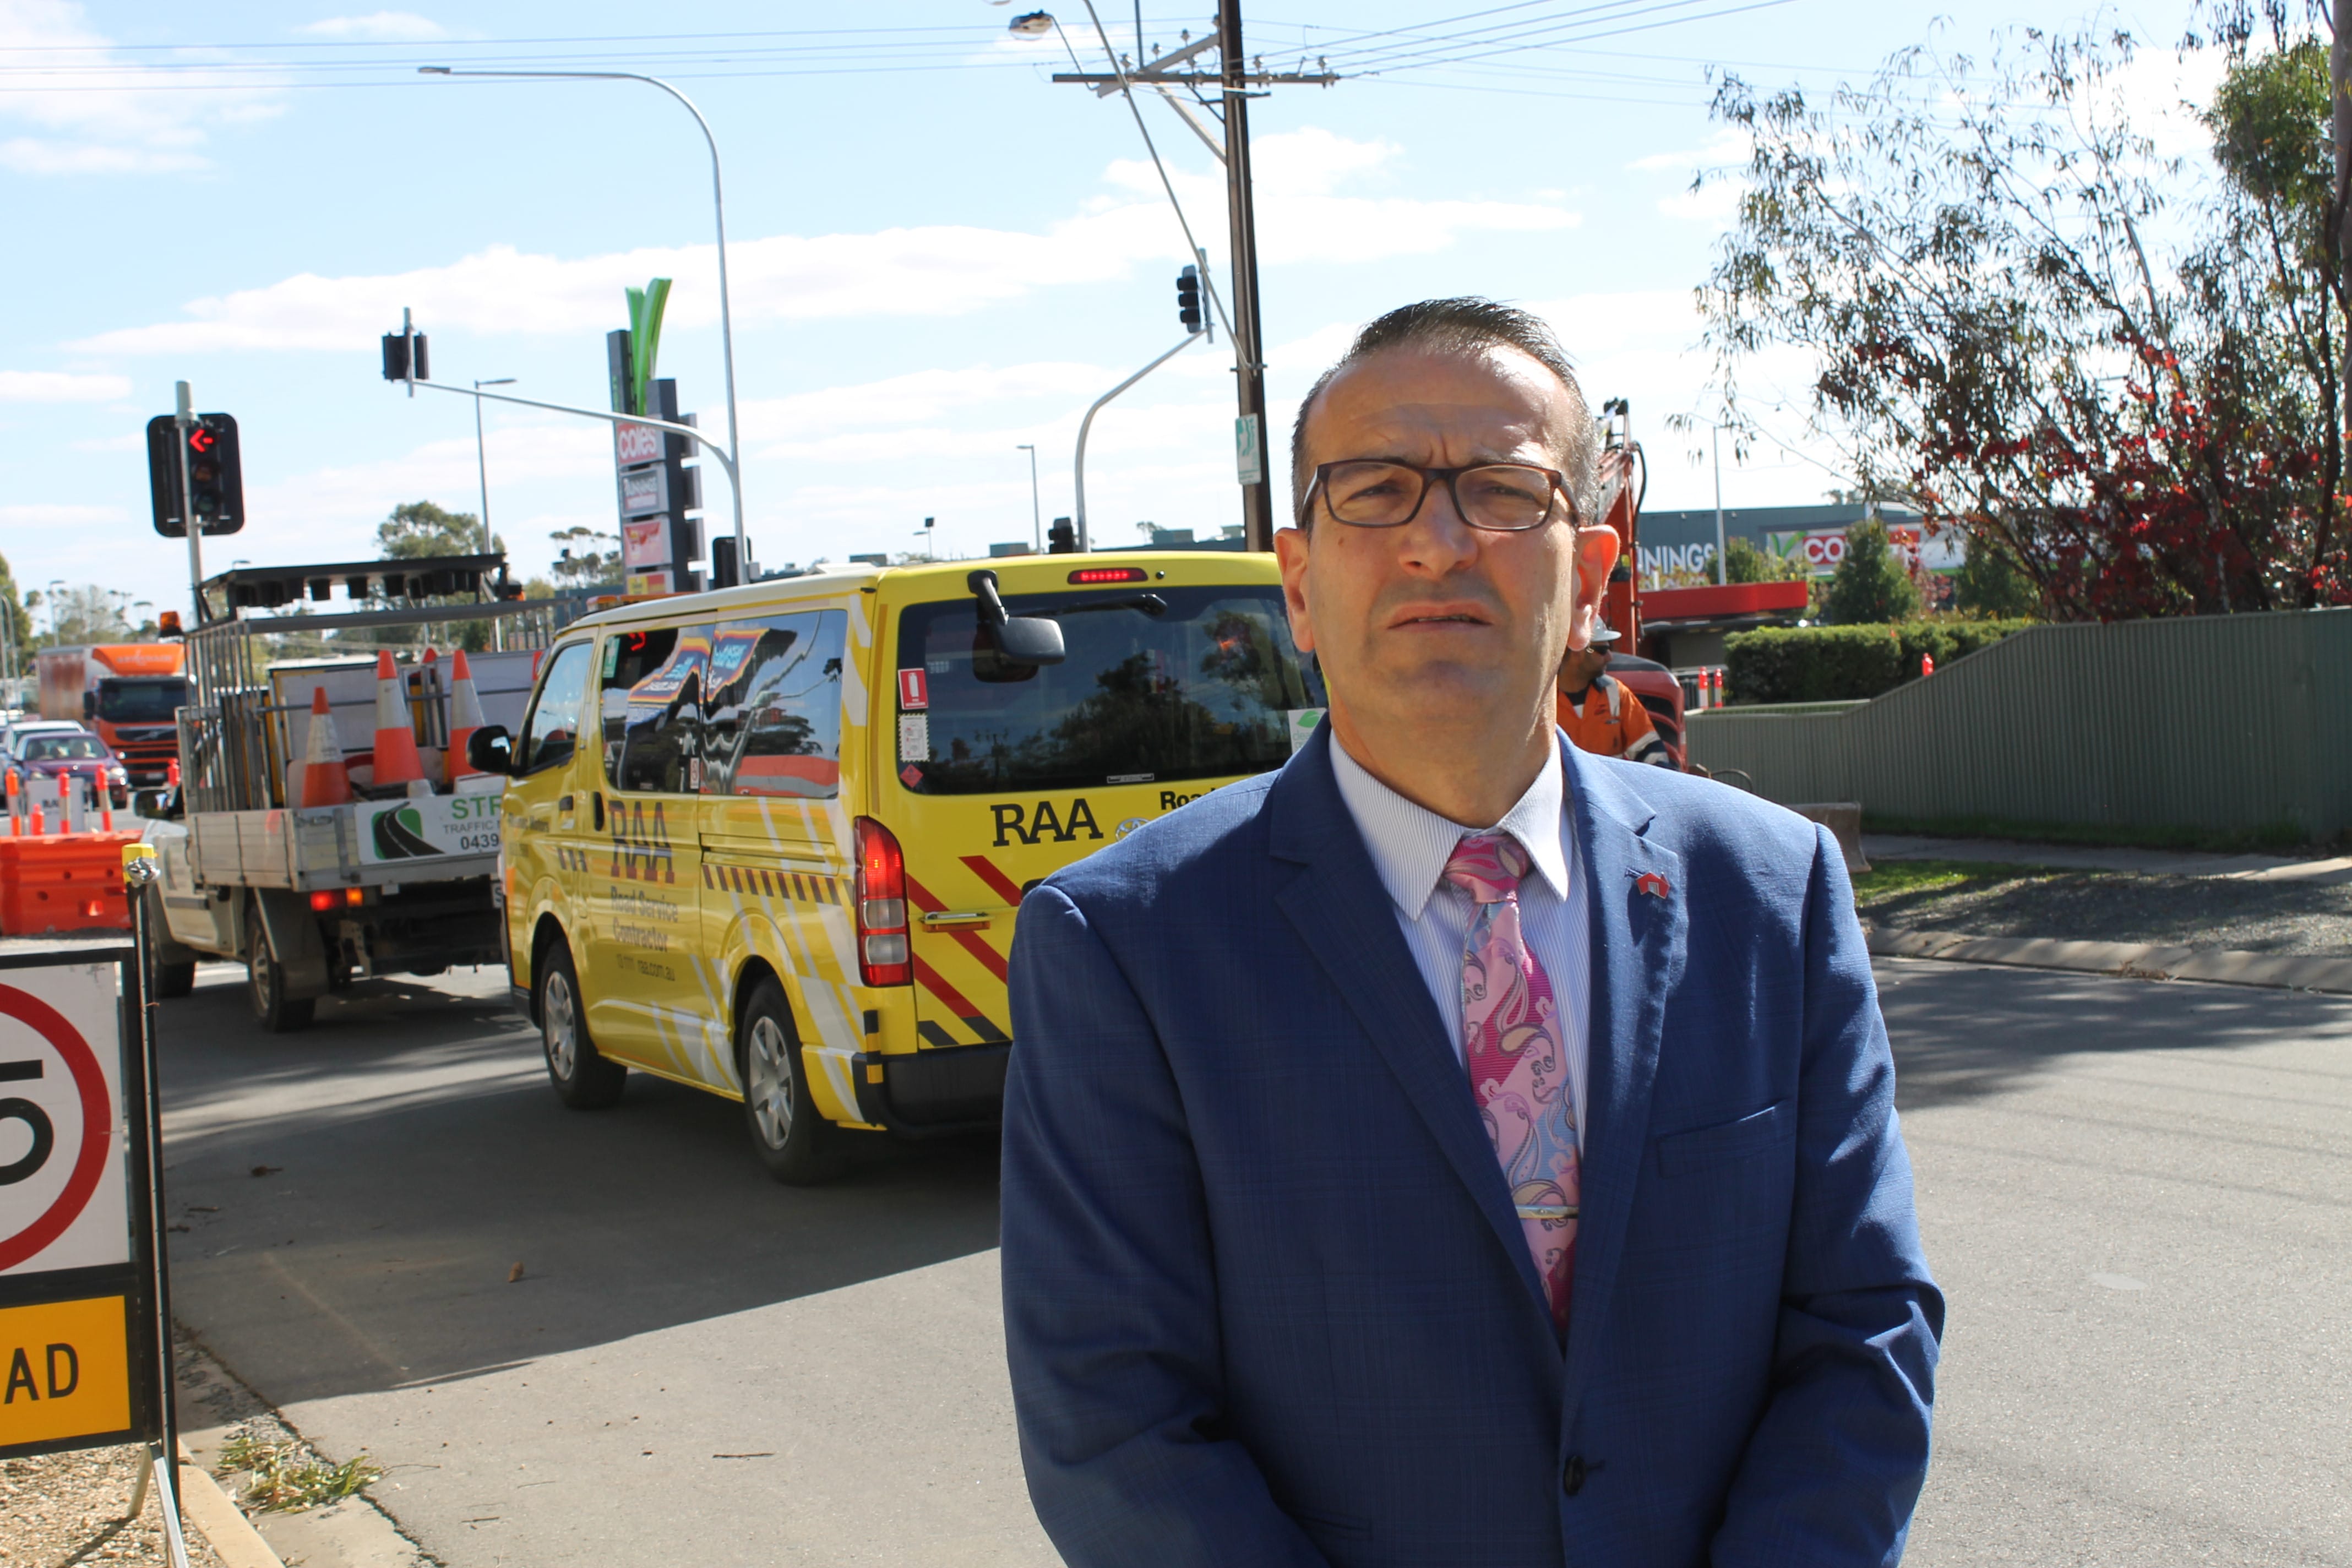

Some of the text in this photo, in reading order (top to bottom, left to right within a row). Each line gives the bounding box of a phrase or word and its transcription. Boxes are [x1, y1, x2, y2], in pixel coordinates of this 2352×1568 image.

[1159, 787, 1217, 810] Ro
[443, 820, 494, 834] TRAFFIC
[990, 798, 1104, 847] RAA
[460, 833, 499, 850] 0439
[608, 800, 675, 884] RAA
[611, 885, 678, 923] Road Service
[613, 916, 668, 952] Contractor
